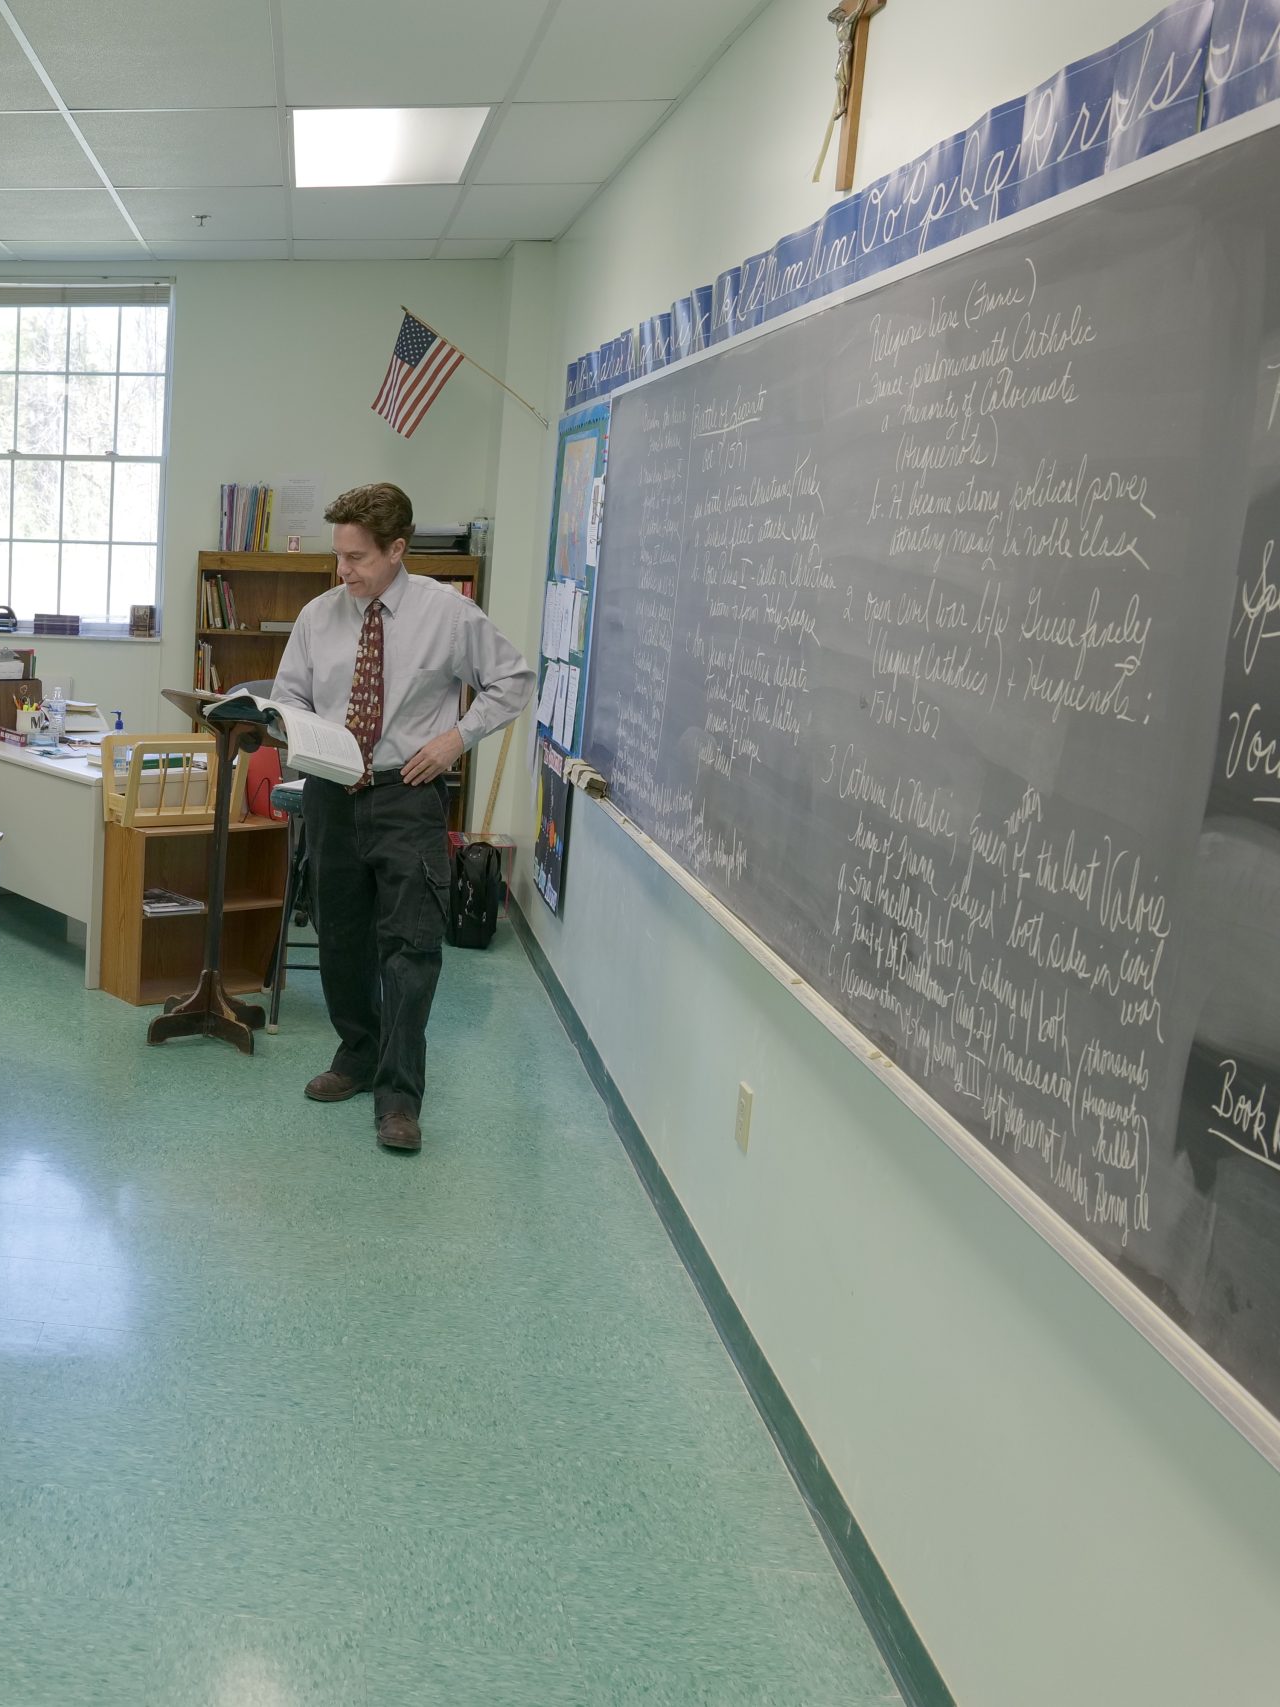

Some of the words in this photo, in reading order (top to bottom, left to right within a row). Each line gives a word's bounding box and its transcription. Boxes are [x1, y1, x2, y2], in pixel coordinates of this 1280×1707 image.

[1012, 304, 1097, 363] Catholic
[1006, 453, 1089, 538] political
[1212, 1059, 1269, 1158] Book
